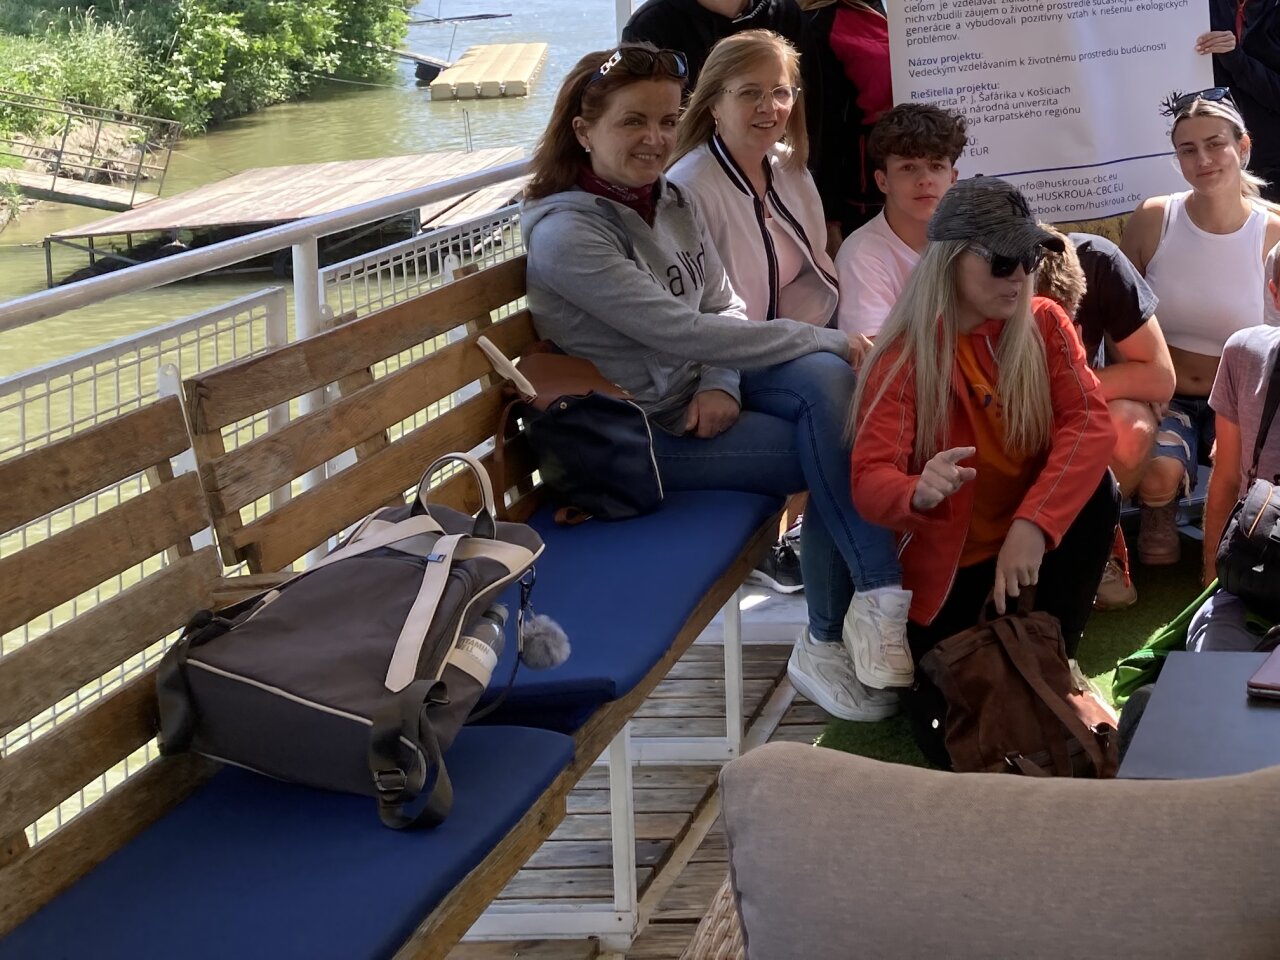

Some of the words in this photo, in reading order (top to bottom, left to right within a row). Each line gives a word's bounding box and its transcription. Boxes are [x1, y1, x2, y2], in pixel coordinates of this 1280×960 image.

[905, 12, 925, 24] nich
[926, 9, 963, 22] vzbudili
[1046, 0, 1091, 13] prostredie
[940, 0, 948, 12] je
[905, 23, 951, 38] generácie
[965, 15, 1016, 31] vybudovali
[1100, 4, 1133, 16] riešeniu
[908, 56, 938, 68] Názov
[940, 51, 984, 66] projektu:
[1027, 54, 1077, 66] životnému
[1079, 48, 1119, 62] prostrediu
[1121, 42, 1167, 55] budúcnosti
[911, 86, 954, 100] Riešitelia
[956, 82, 1000, 96] projektu:
[978, 89, 1017, 102] Šafárika
[1027, 85, 1071, 97] Košiciach
[969, 102, 1010, 114] národná
[1012, 97, 1059, 110] univerzita
[983, 109, 1043, 124] karpatského
[1044, 106, 1081, 118] regiónu
[970, 146, 990, 157] EUR
